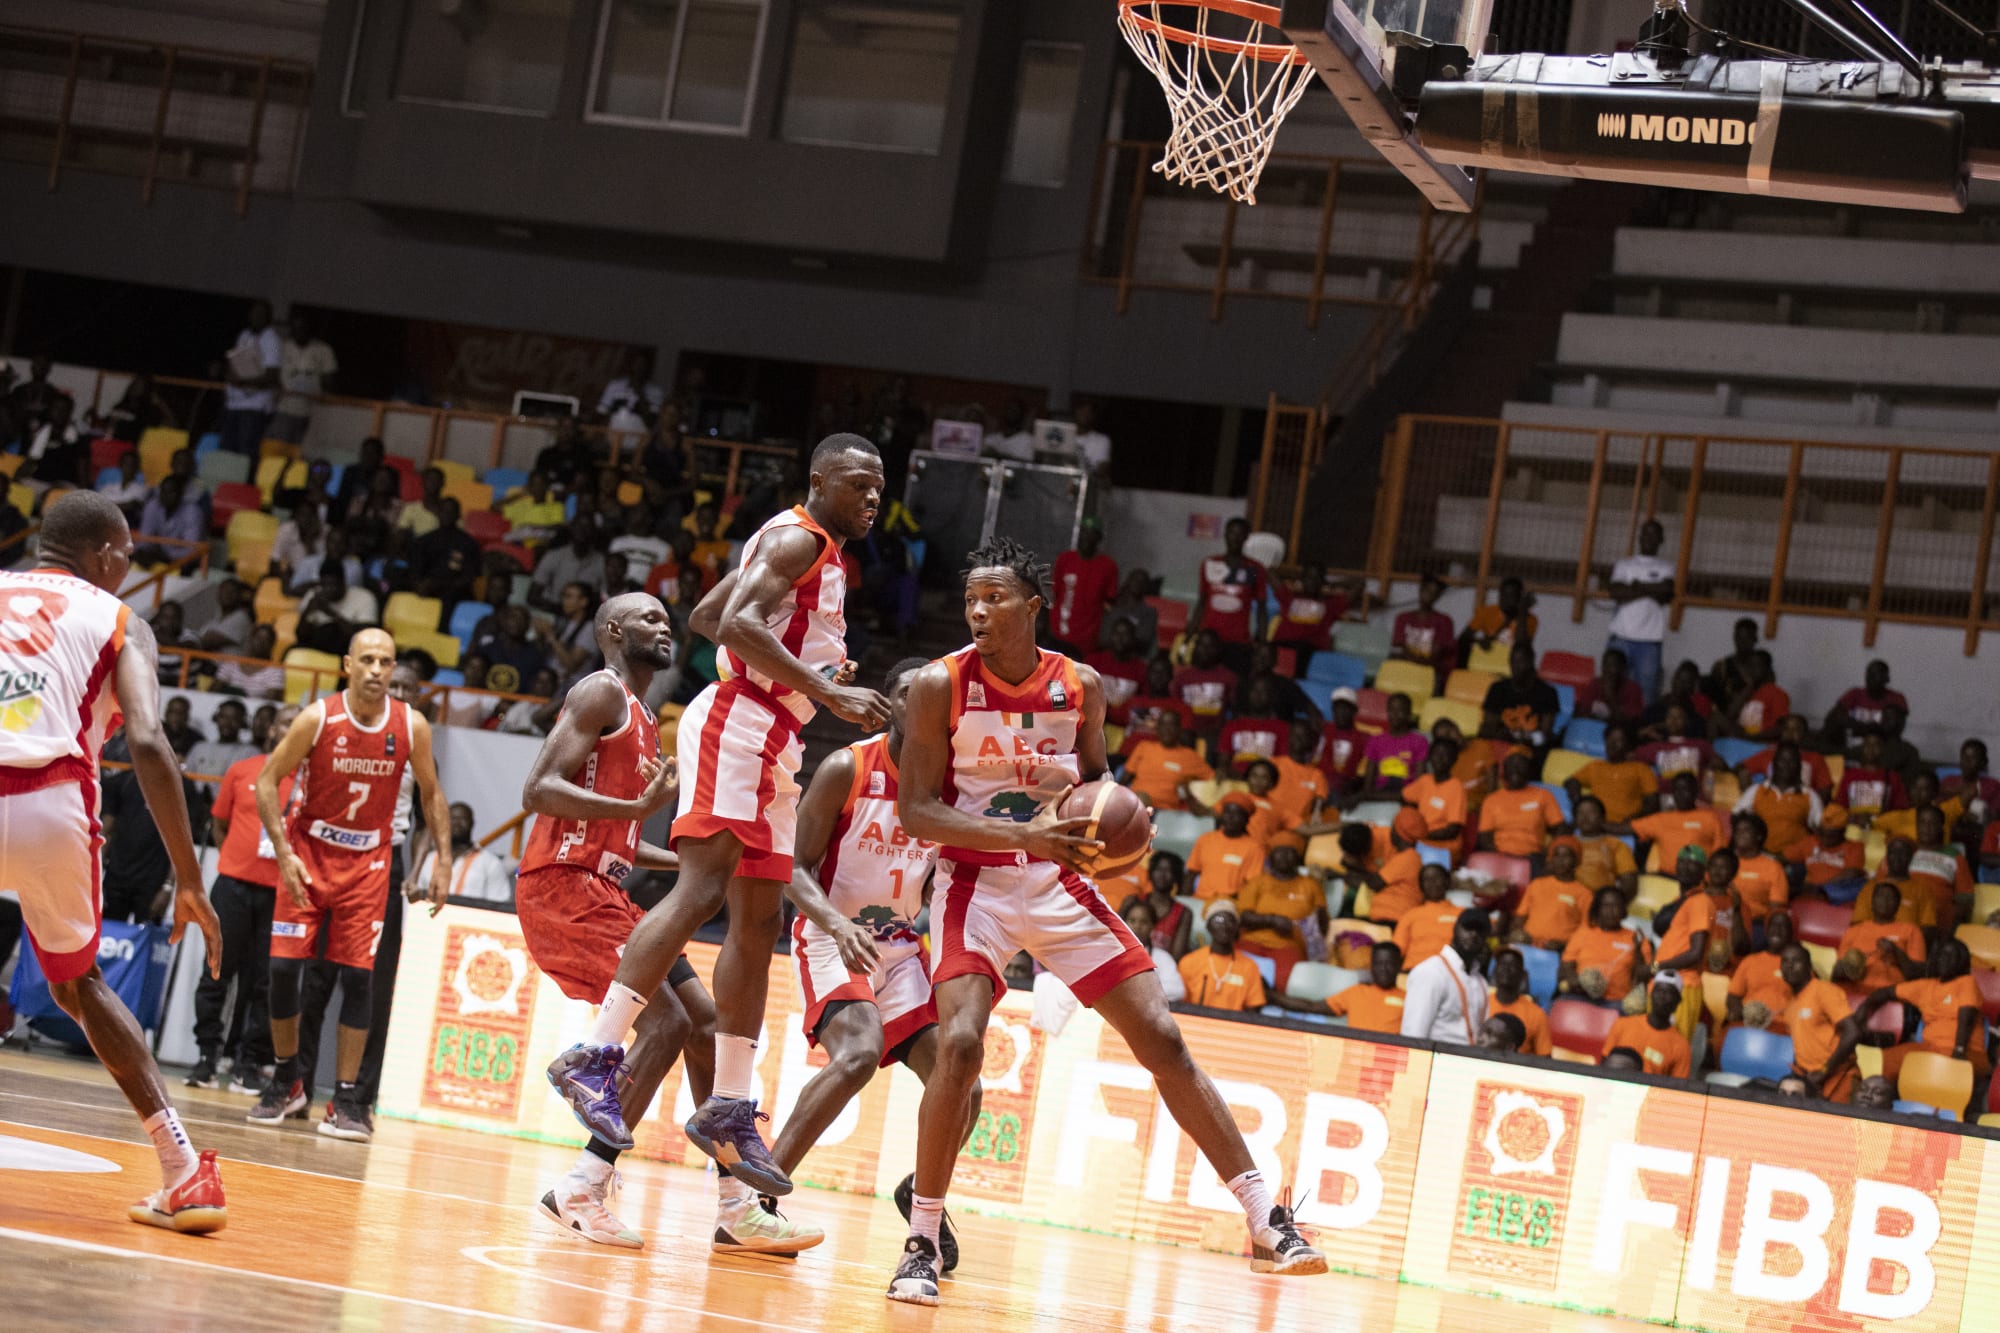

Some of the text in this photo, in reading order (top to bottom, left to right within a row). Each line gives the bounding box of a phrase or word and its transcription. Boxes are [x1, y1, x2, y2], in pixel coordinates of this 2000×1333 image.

[1630, 113, 1758, 146] MOND
[977, 735, 1058, 756] ABC
[332, 757, 396, 776] MOROCCO
[346, 781, 371, 821] 7
[319, 826, 372, 847] 1XBET
[857, 841, 935, 862] FIGHTERS
[889, 869, 904, 899] 1
[369, 920, 385, 956] 7
[434, 1026, 517, 1082] FIBB
[1465, 1187, 1554, 1248] FIBB
[1590, 1142, 1942, 1320] FIBB
